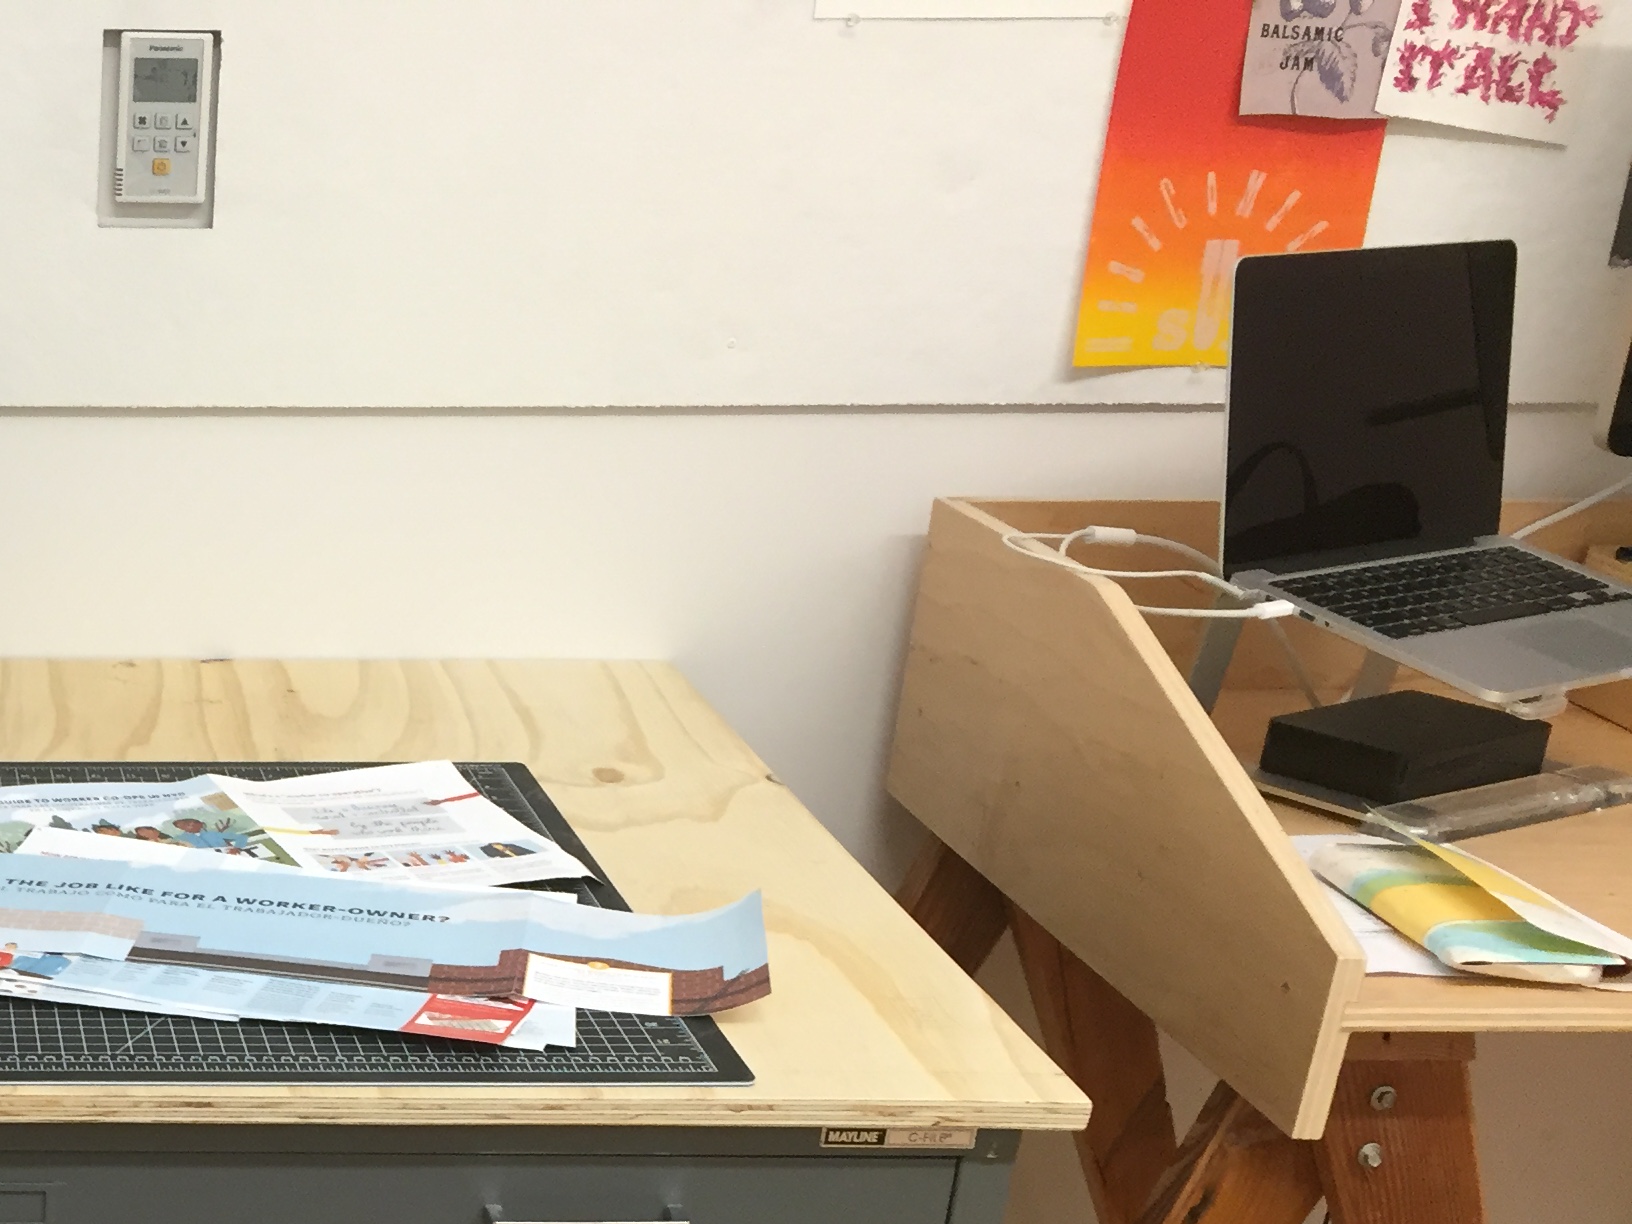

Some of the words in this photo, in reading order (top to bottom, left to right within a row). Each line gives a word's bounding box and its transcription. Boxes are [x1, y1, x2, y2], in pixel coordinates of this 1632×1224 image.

[1260, 23, 1344, 43] BALSAMIC
[1279, 54, 1314, 71] JAM
[1393, 39, 1465, 93] IT
[1455, 42, 1566, 123] ALL
[6, 878, 50, 889] THE
[54, 881, 99, 891] JOB
[106, 882, 154, 896] LIKE
[161, 890, 206, 902] FOR
[211, 894, 228, 903] A
[236, 896, 451, 923] WORKER-OWNER?
[17, 887, 91, 897] TRABAJO
[149, 897, 190, 908] PARA
[827, 1131, 879, 1143] MAYLINE
